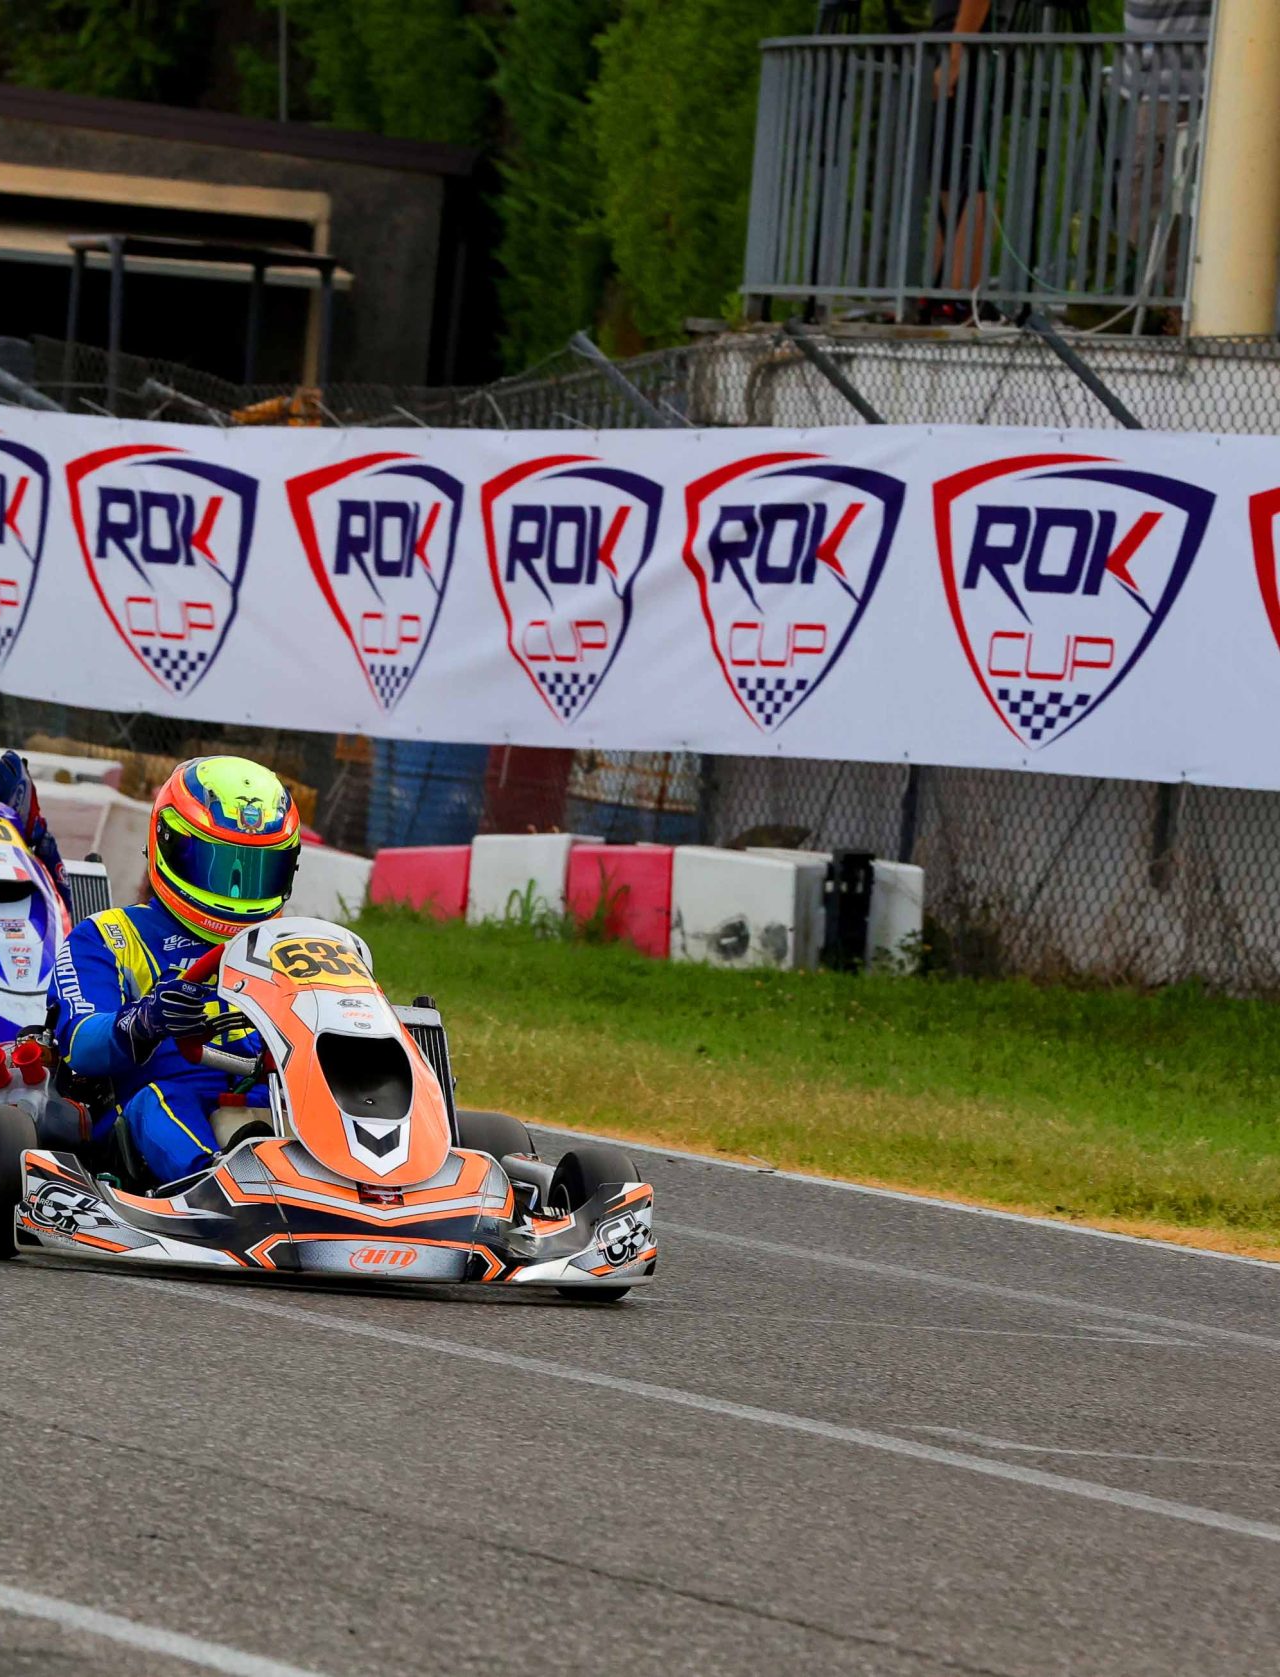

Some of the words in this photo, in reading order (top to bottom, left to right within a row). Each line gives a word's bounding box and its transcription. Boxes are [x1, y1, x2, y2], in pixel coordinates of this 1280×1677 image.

[95, 486, 224, 591] ROK
[334, 499, 441, 604] ROK
[506, 505, 631, 607] ROK
[709, 501, 865, 614] ROK
[962, 505, 1164, 625] ROK
[126, 597, 214, 640] CUP
[361, 613, 419, 654] CUP
[523, 621, 608, 662] CUP
[729, 623, 826, 666] CUP
[987, 631, 1114, 681] CUP
